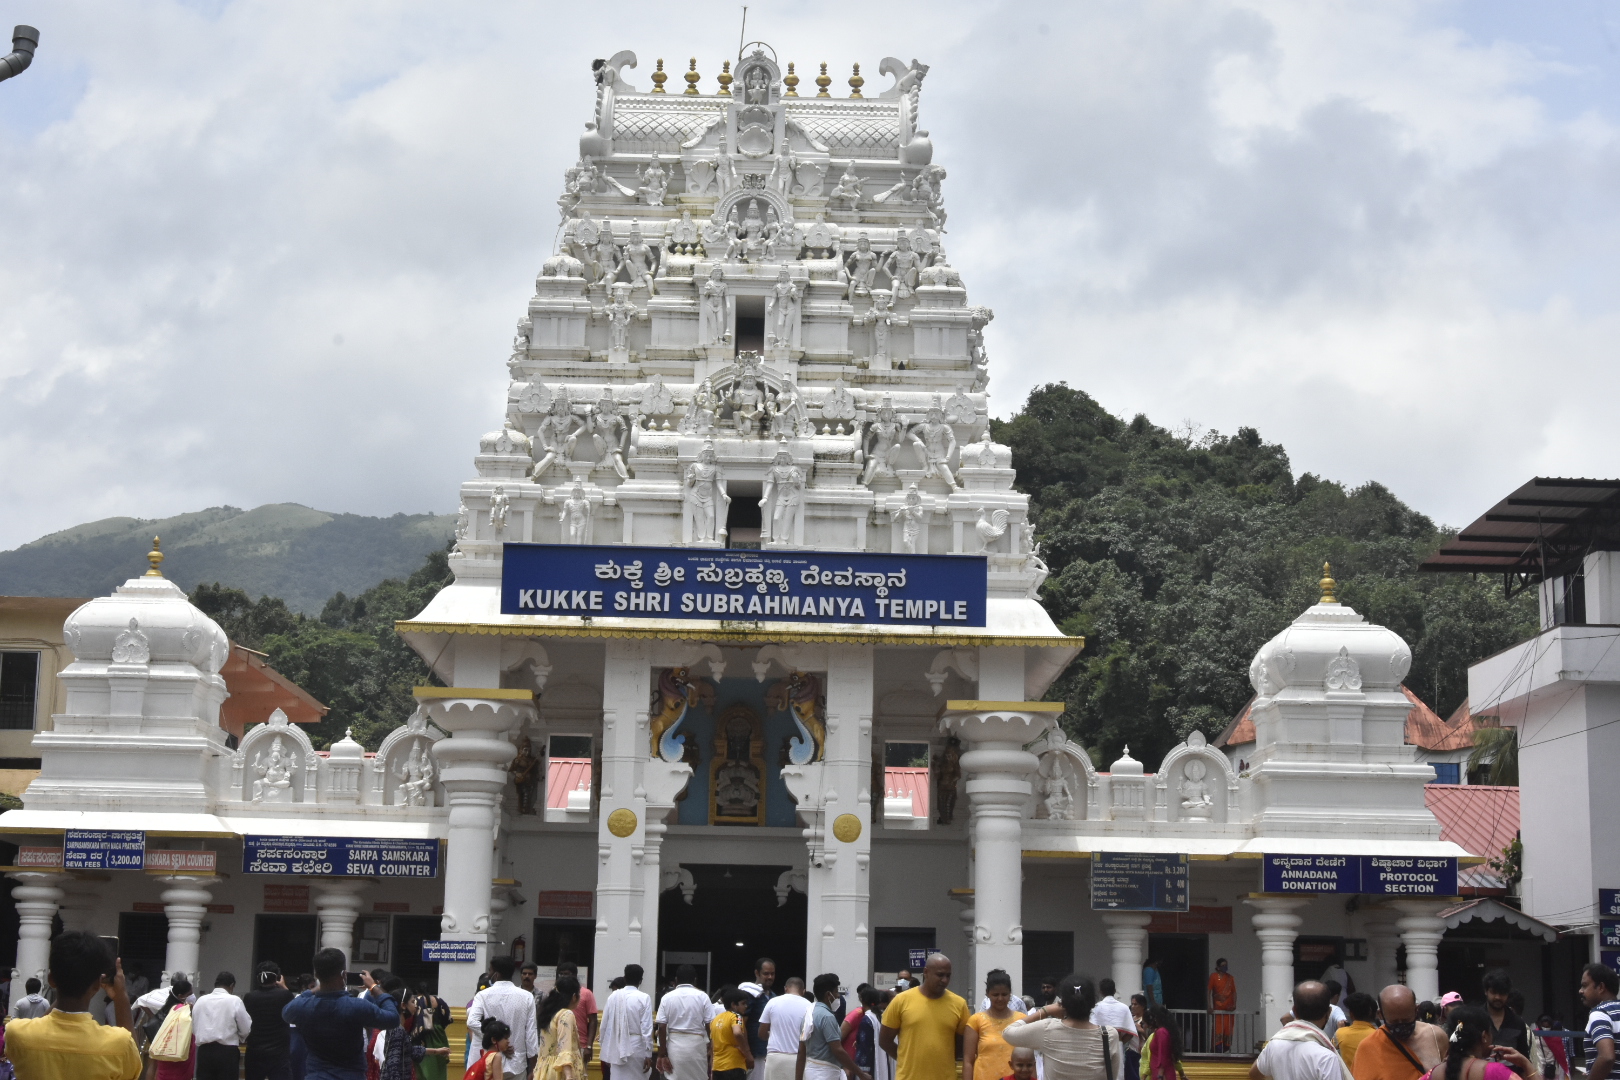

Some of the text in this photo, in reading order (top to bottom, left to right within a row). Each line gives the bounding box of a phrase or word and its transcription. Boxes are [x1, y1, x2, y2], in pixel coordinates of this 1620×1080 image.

[595, 559, 907, 597] ಕುಕ್ಕೆ ಶ್ರೀ ಸುಬ್ರಹ್ಮಣ್ಯ ದೇವಸ್ಥಾನ
[519, 589, 968, 620] KUKKE SHRI SUBRAHMANYA TEMPLE
[111, 842, 121, 850] NAGA
[66, 851, 103, 860] ಸೇವಾ ದರ
[257, 847, 327, 860] ಸರ್ಪಸಂಸ್ಕಾರ
[349, 850, 430, 861] SARPA SAMSKARA
[111, 855, 141, 866] 3,200.00
[172, 854, 186, 866] SEVA
[187, 854, 214, 867] COUNTER
[1272, 857, 1346, 869] ಅನ್ನದಾನ ದೇಣಿಗೆ
[1417, 859, 1448, 869] ವಿಭಾಗ
[250, 859, 333, 874] ಸೇವಾ ಕಛೇರಿ
[346, 863, 430, 876] SEVA COUNTER
[1281, 870, 1338, 879] ANNADANA
[1380, 873, 1439, 882] PROTOCOL
[1282, 881, 1336, 890] DONATION
[1385, 884, 1434, 893] SECTION
